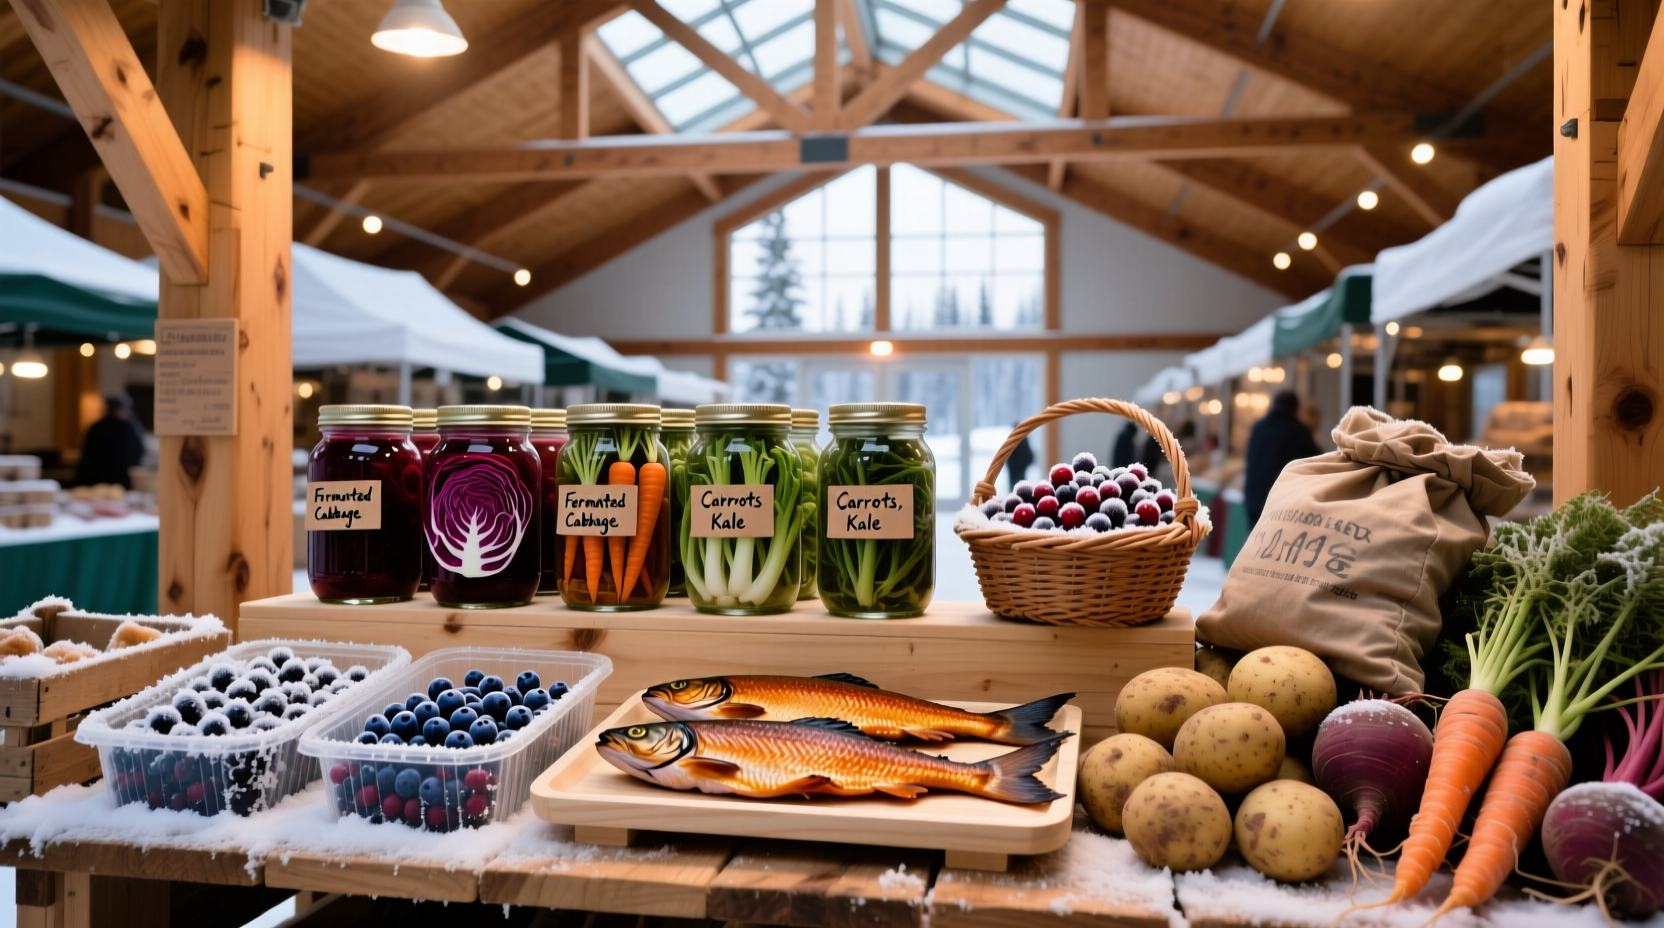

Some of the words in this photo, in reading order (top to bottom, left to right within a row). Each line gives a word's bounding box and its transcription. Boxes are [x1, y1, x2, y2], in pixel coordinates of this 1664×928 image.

[701, 490, 762, 508] Carrots
[836, 491, 902, 511] Carrots,
[711, 512, 746, 530] Kale
[847, 513, 881, 532] Kale
